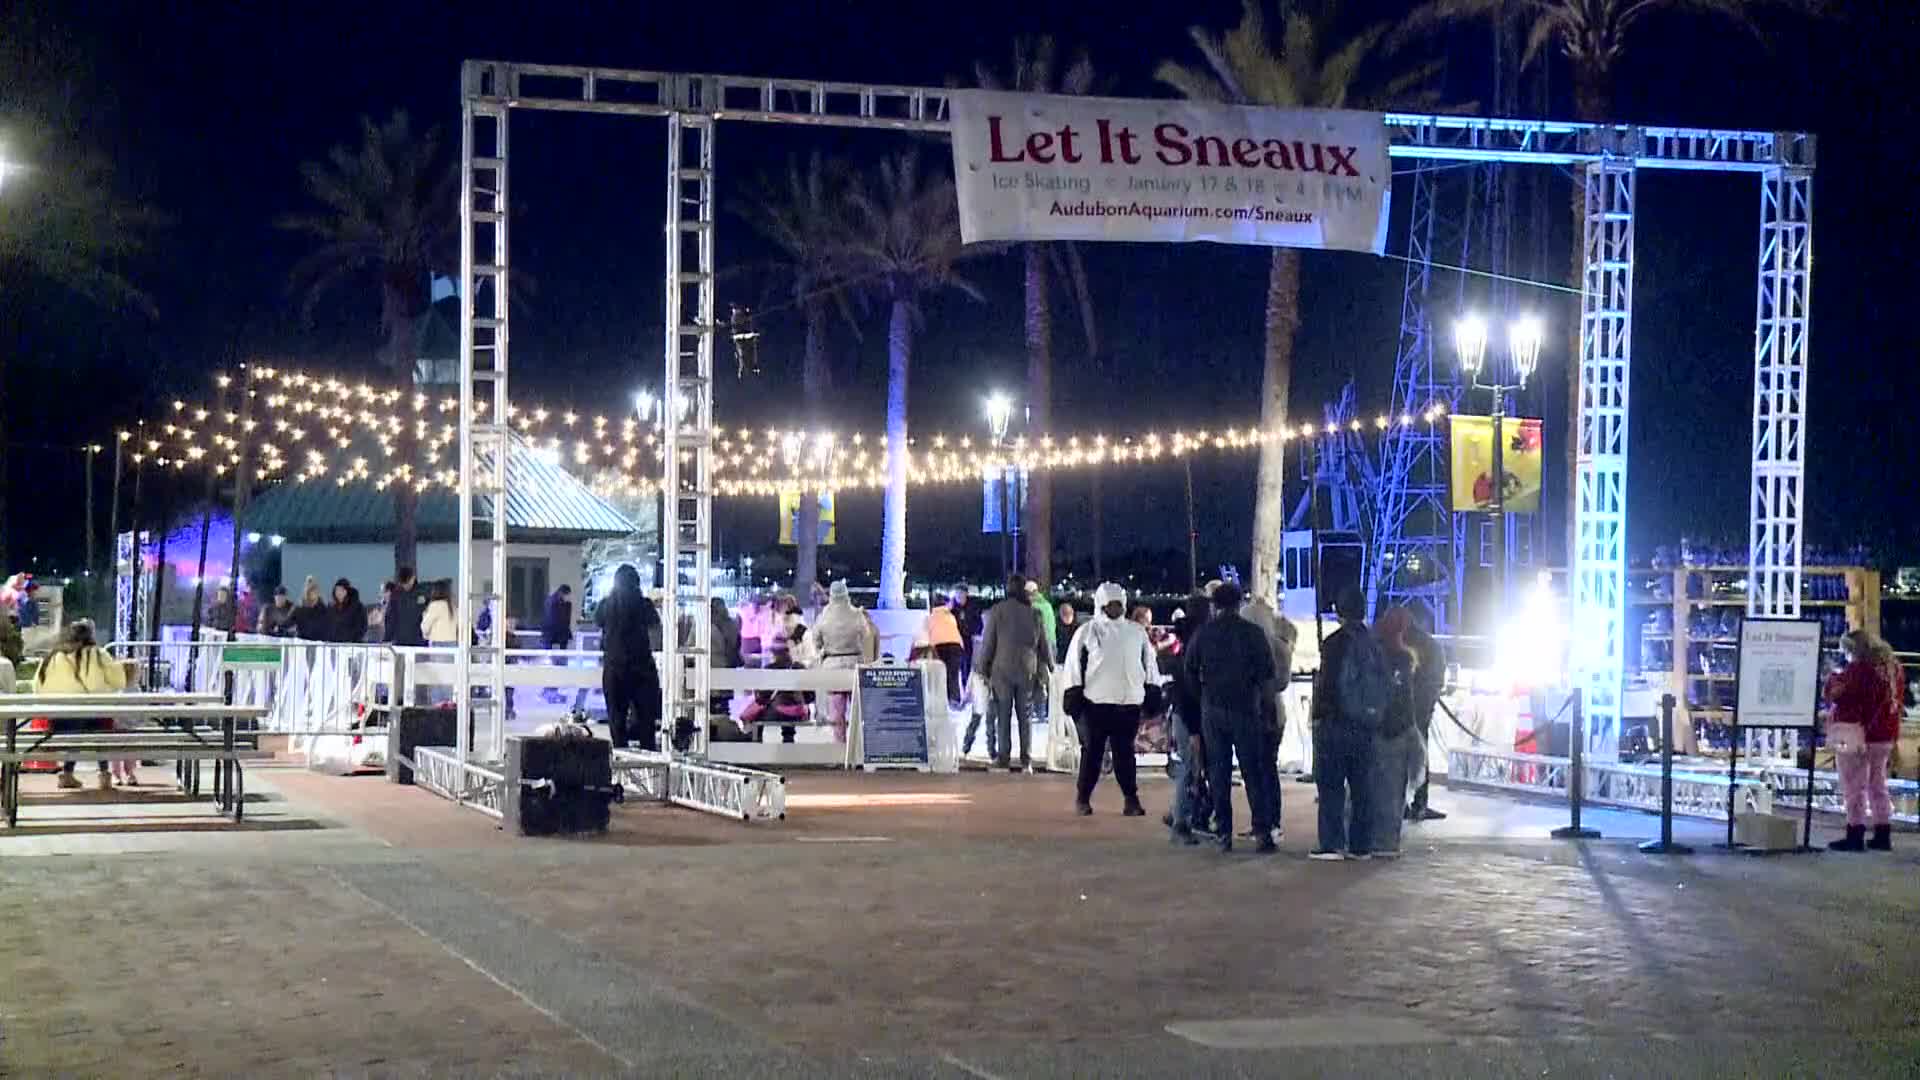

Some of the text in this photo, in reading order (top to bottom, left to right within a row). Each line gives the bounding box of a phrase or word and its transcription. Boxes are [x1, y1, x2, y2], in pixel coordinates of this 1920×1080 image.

[987, 115, 1360, 177] Let It Sneaux
[992, 173, 1018, 189] Ice
[1024, 172, 1091, 193] Skating
[1049, 200, 1313, 223] AudubonAquarium.com/Sneaux
